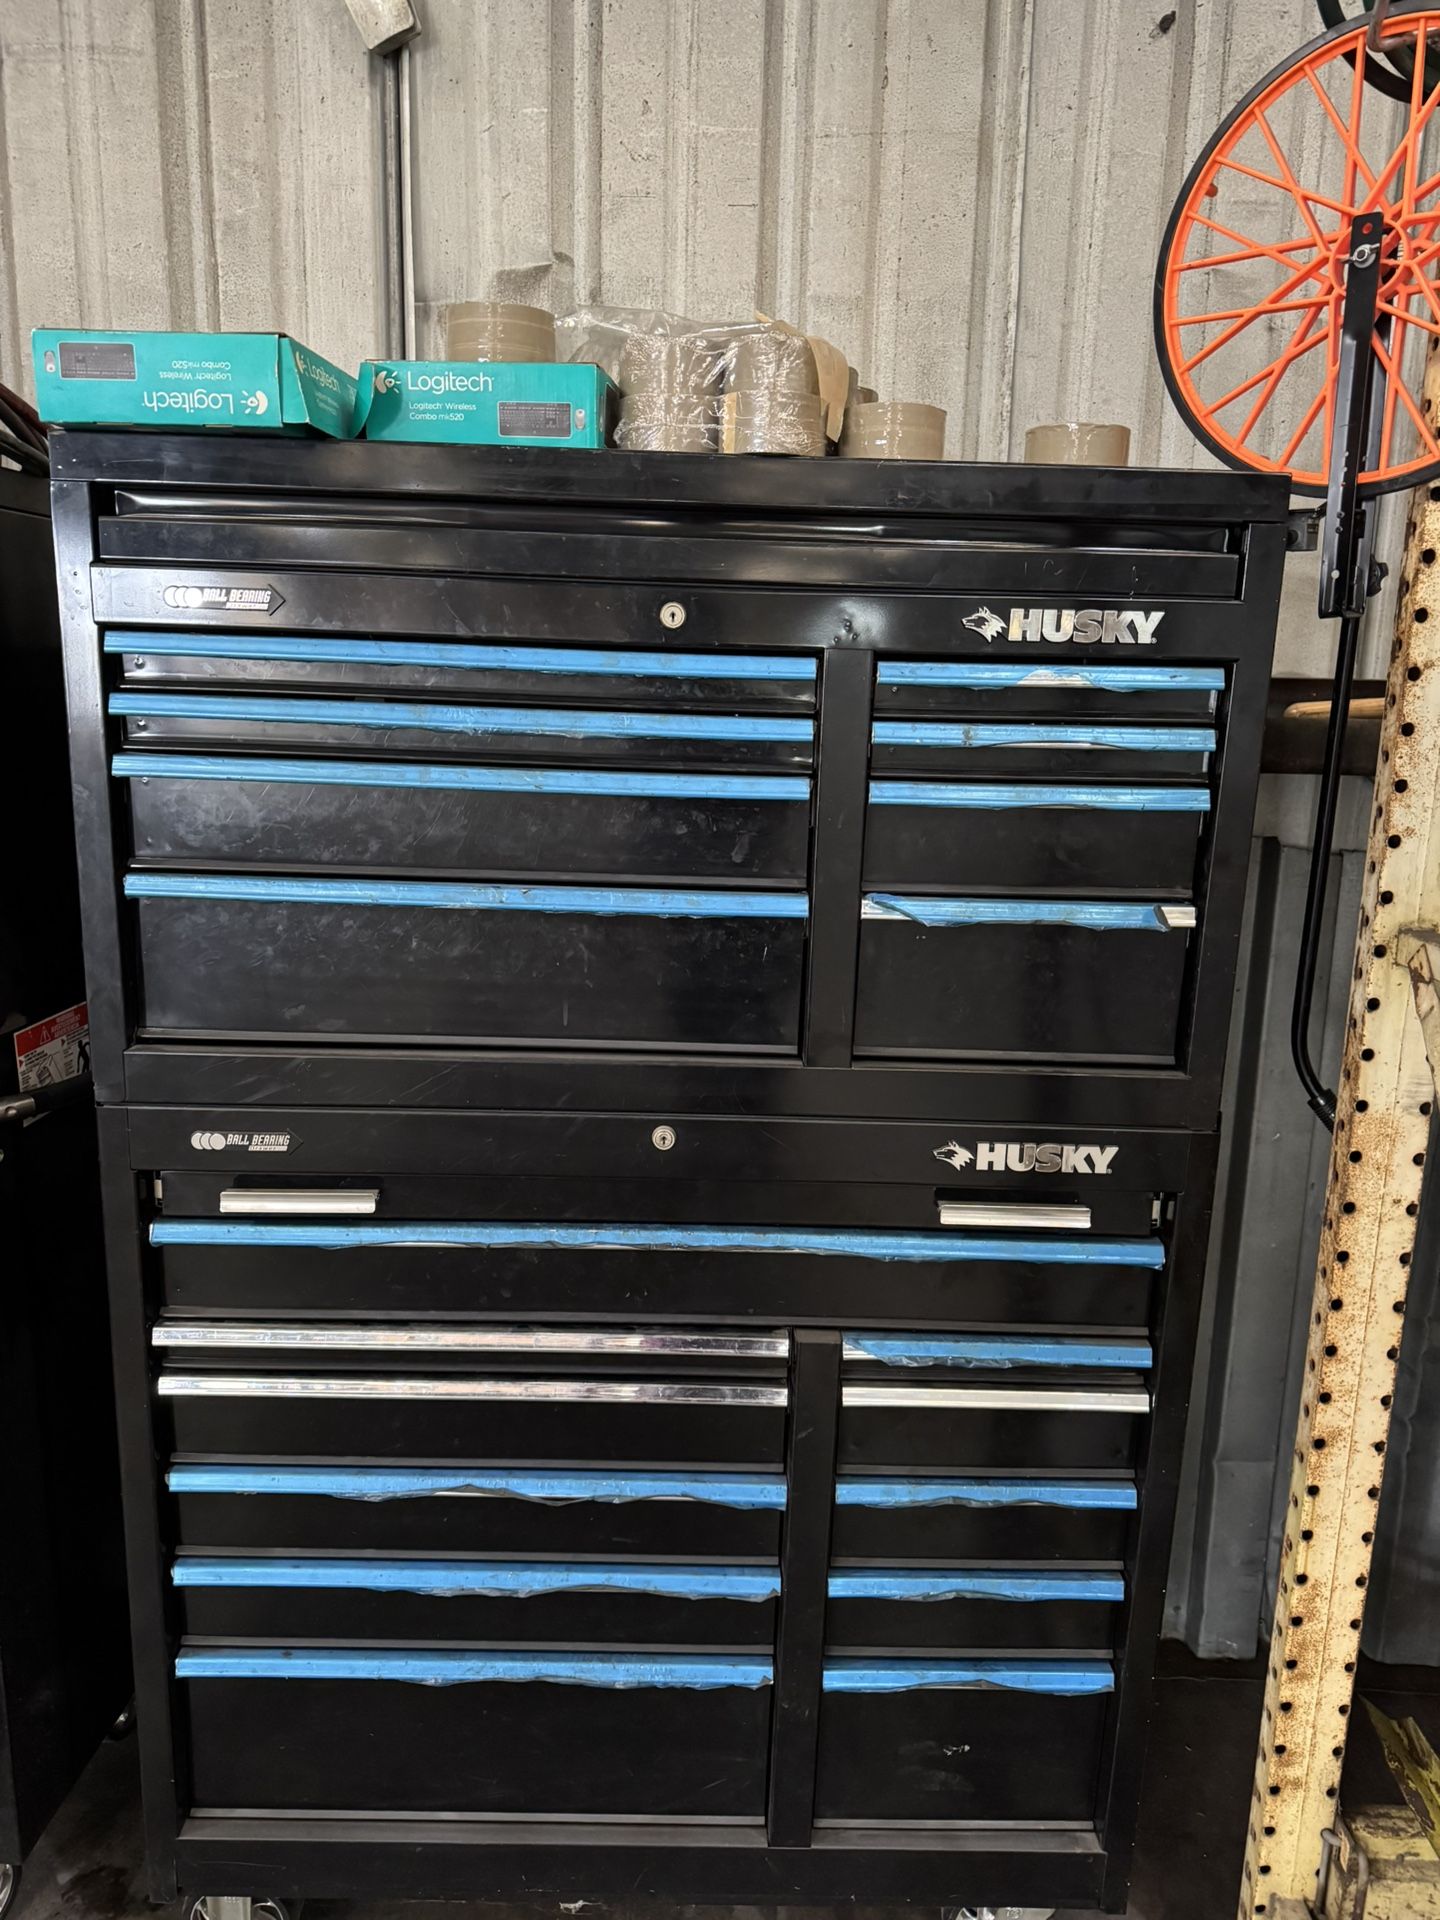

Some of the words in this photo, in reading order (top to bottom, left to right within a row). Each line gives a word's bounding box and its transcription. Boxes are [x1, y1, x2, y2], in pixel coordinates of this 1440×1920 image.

[172, 360, 200, 369] mk520
[201, 361, 231, 370] Combo
[159, 371, 192, 380] Wireless
[193, 371, 231, 381] Logitech
[407, 370, 493, 395] Logitech
[143, 388, 233, 415] Logitech
[409, 402, 441, 411] Logitech
[445, 402, 476, 411] Wireless
[409, 412, 437, 420] Combo
[438, 412, 464, 421] mk520
[203, 588, 227, 602] BALL
[229, 589, 272, 603] BEARING
[1008, 607, 1165, 644] HUSKY
[226, 1133, 249, 1146] BALL
[251, 1134, 290, 1146] BEARING
[976, 1142, 1119, 1174] HUSKY
